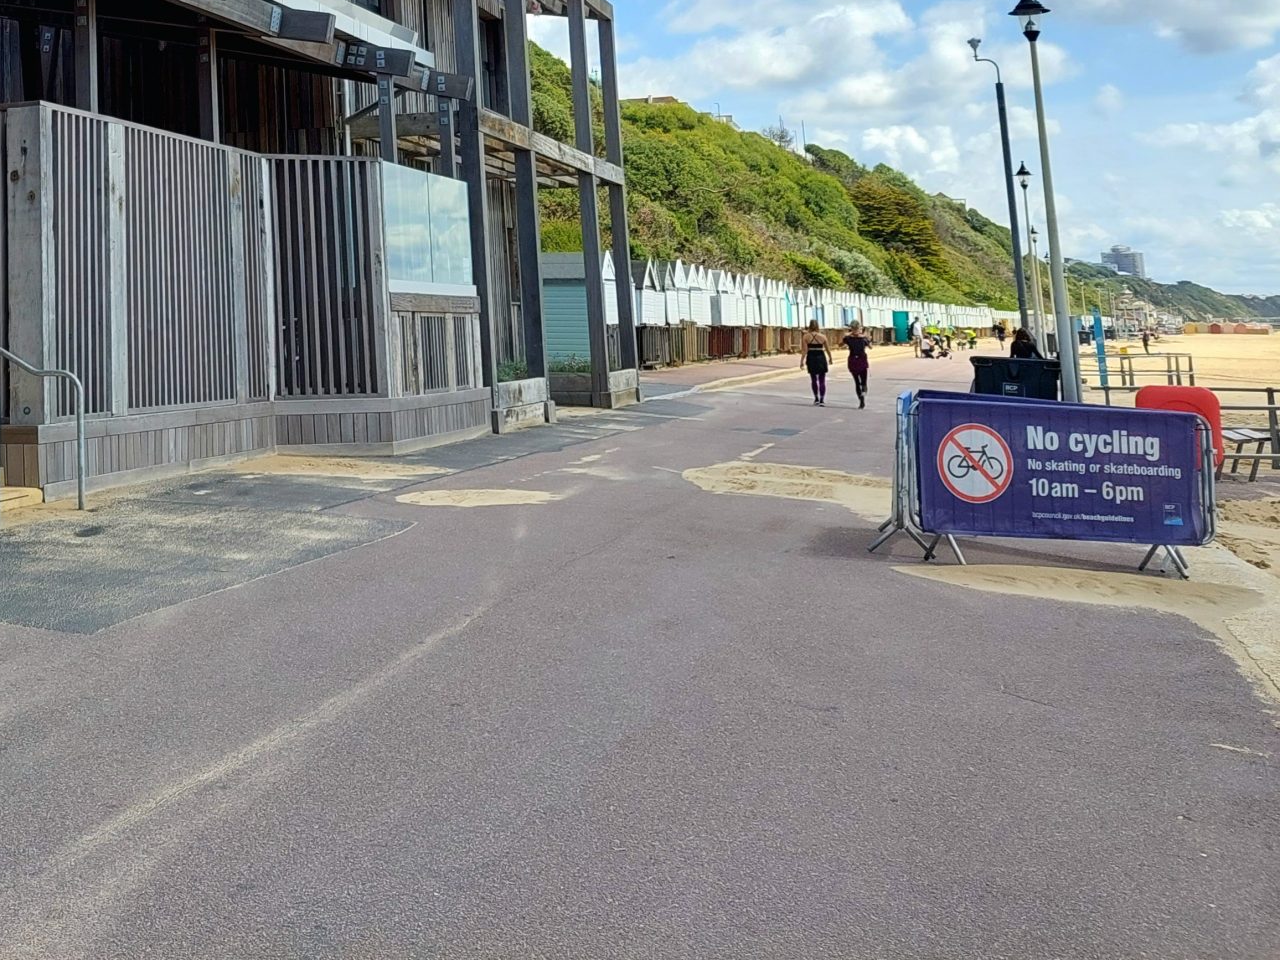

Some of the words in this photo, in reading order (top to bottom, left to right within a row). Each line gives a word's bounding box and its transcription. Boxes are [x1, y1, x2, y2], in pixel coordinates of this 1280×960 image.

[1026, 425, 1060, 451] No
[1069, 430, 1160, 461] cycling
[1027, 458, 1042, 471] No
[1045, 459, 1086, 475] skating
[1089, 463, 1101, 473] or
[1103, 463, 1182, 479] skateboarding
[1029, 478, 1079, 498] 10am
[1101, 481, 1144, 505] 6pm
